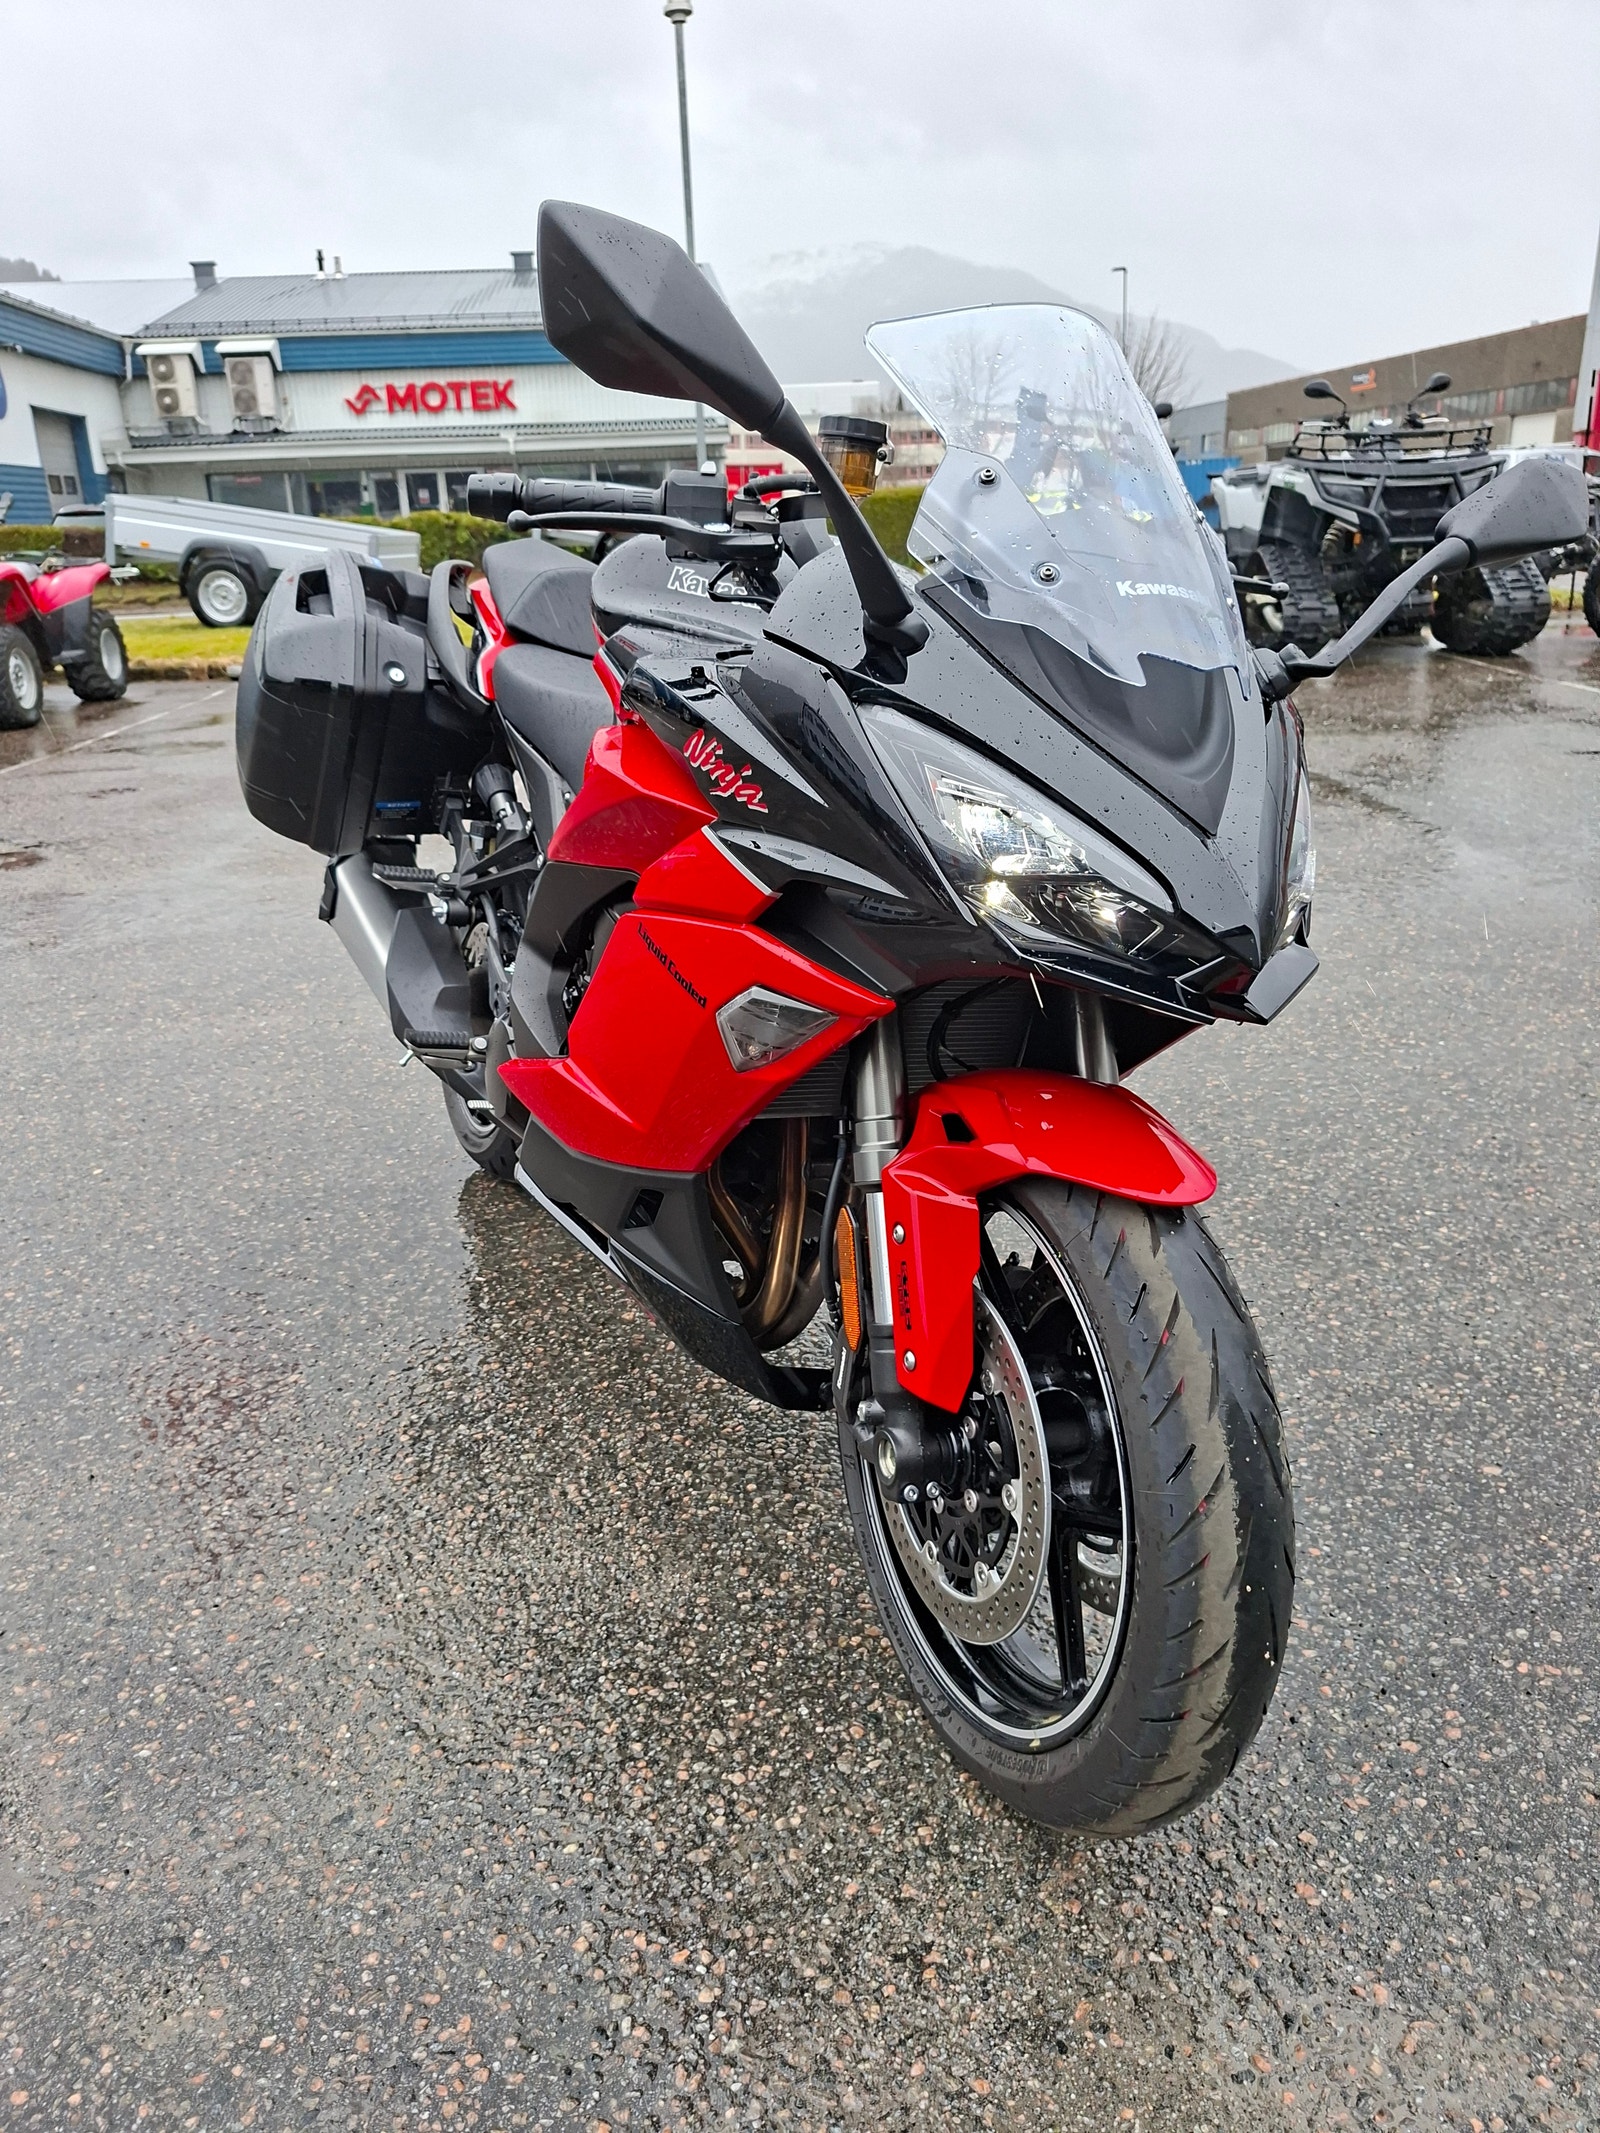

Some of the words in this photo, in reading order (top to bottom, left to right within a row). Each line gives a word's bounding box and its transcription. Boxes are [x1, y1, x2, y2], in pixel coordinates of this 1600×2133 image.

[386, 379, 517, 414] MOTEK
[683, 728, 769, 813] Ninja
[638, 921, 668, 967] Liquid
[667, 960, 707, 1009] Cooled
